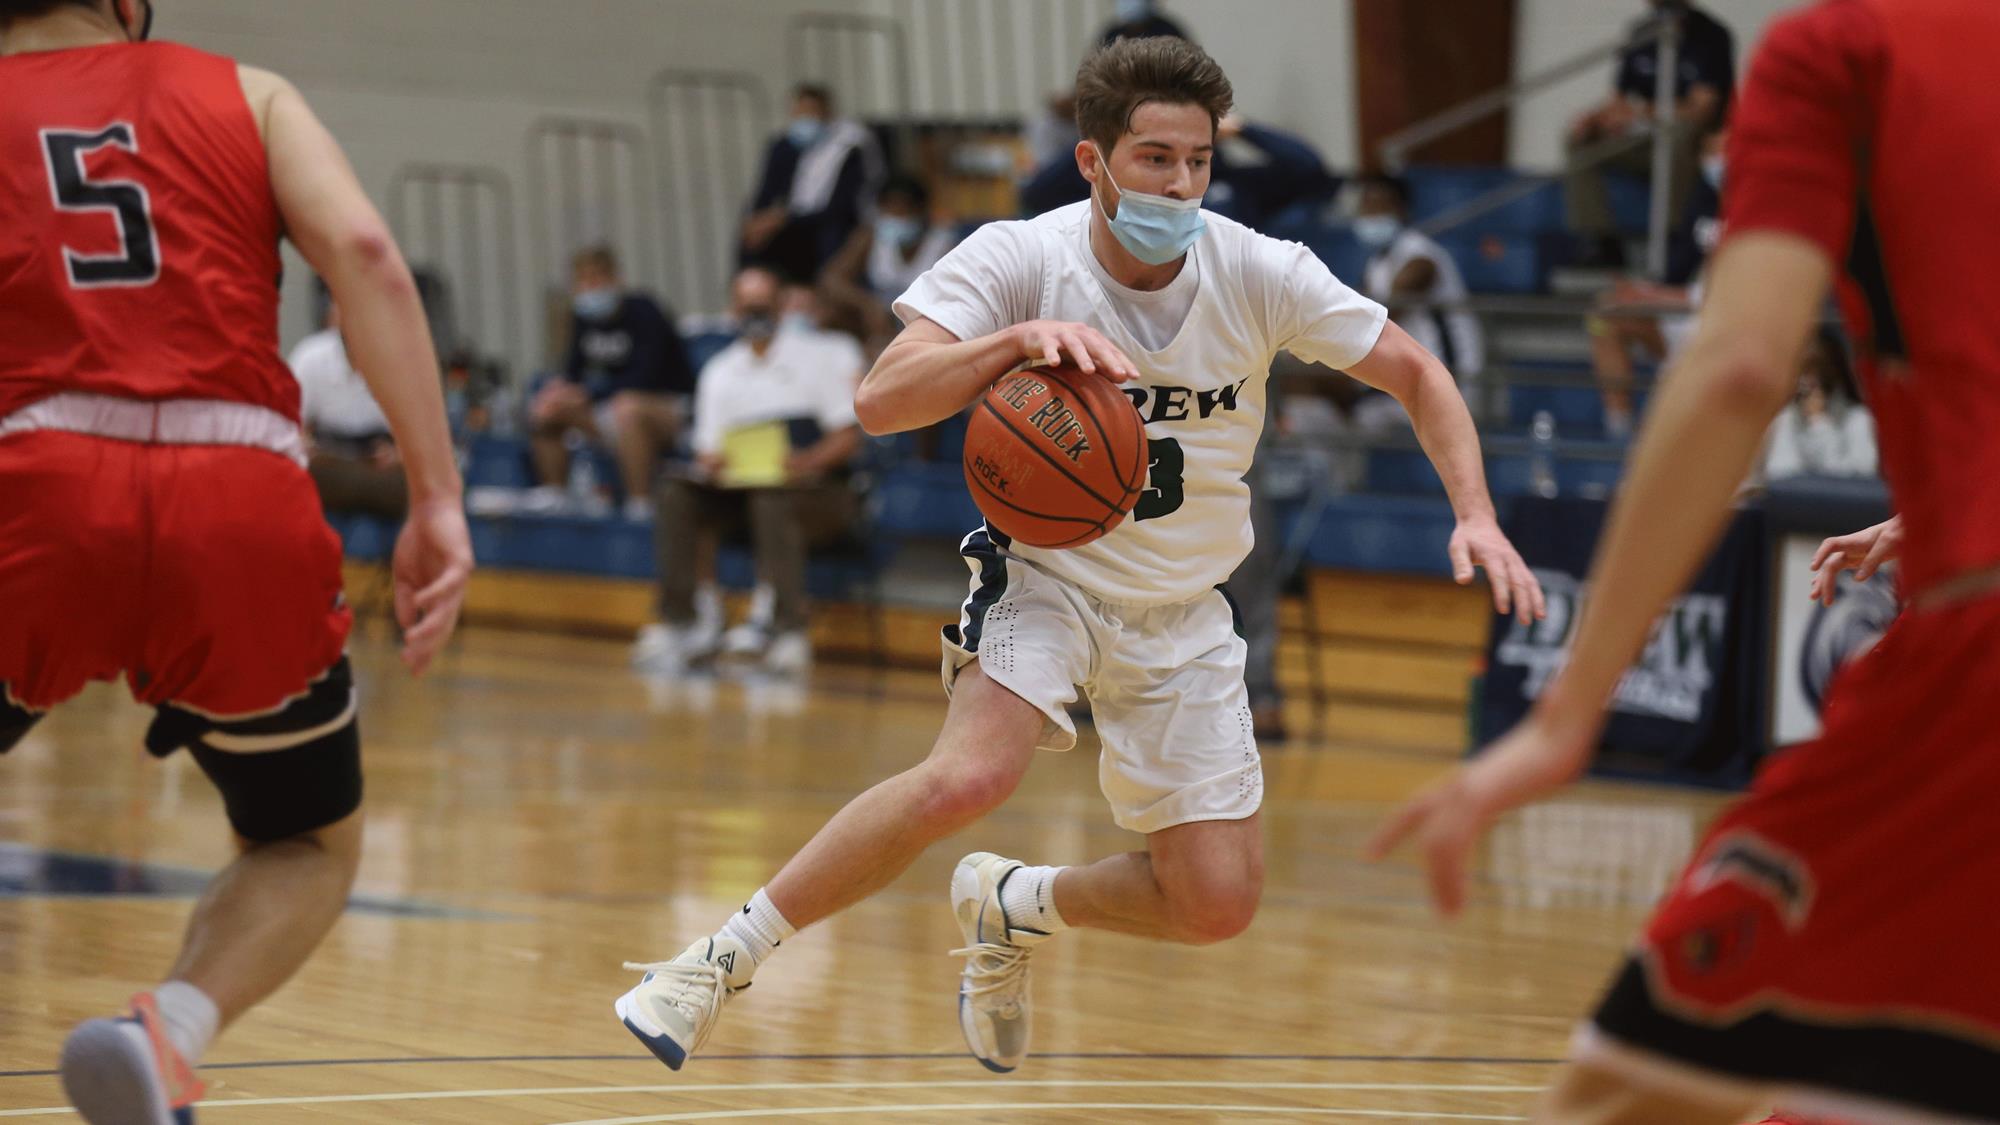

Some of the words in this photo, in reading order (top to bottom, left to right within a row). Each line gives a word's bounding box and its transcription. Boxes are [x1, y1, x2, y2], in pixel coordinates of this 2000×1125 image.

[39, 120, 161, 289] 5
[1027, 396, 1091, 462] ROCK
[1122, 373, 1250, 425] REW
[974, 456, 1009, 493] ROCK
[1133, 437, 1184, 522] 3
